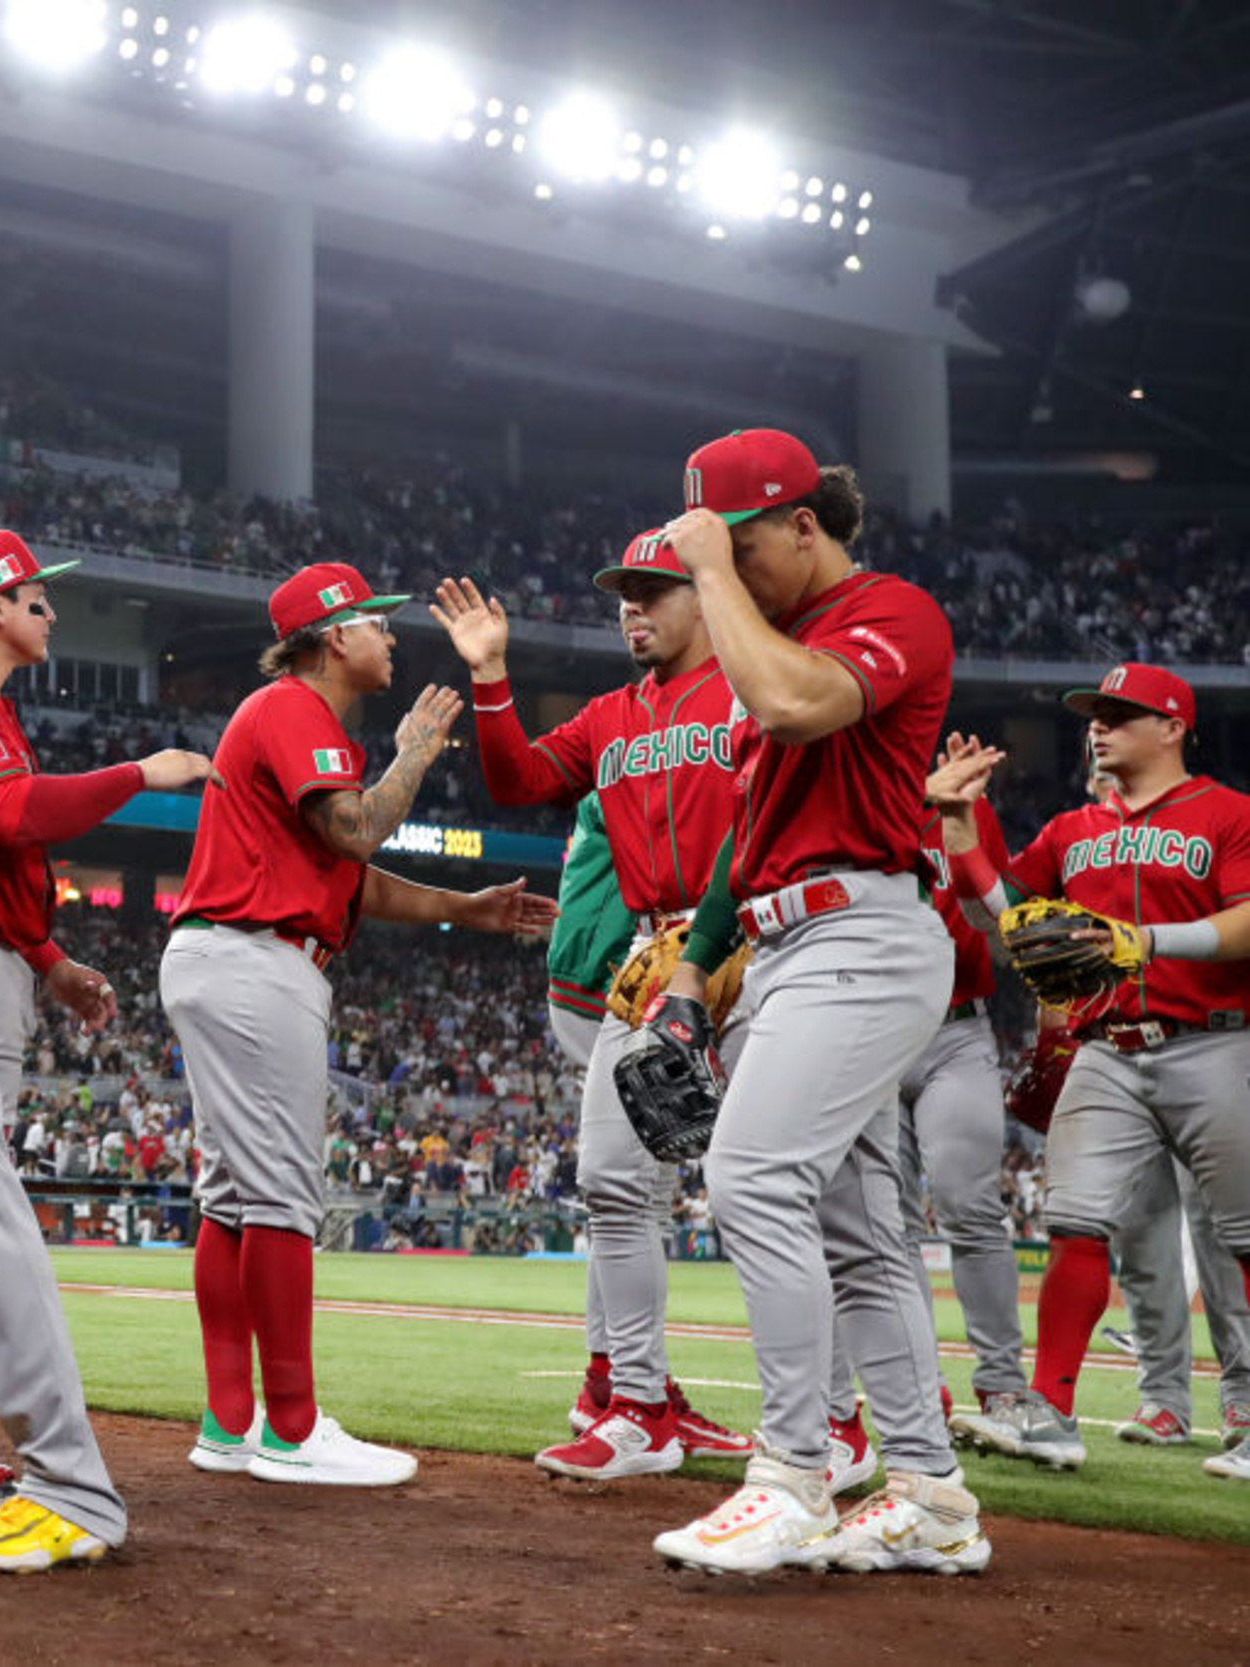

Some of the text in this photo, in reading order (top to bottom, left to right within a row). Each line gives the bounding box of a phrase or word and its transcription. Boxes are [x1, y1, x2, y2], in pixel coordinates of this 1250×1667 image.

[598, 723, 735, 789] MEXICO
[444, 829, 482, 857] 2023
[1063, 825, 1213, 885] MEXICO
